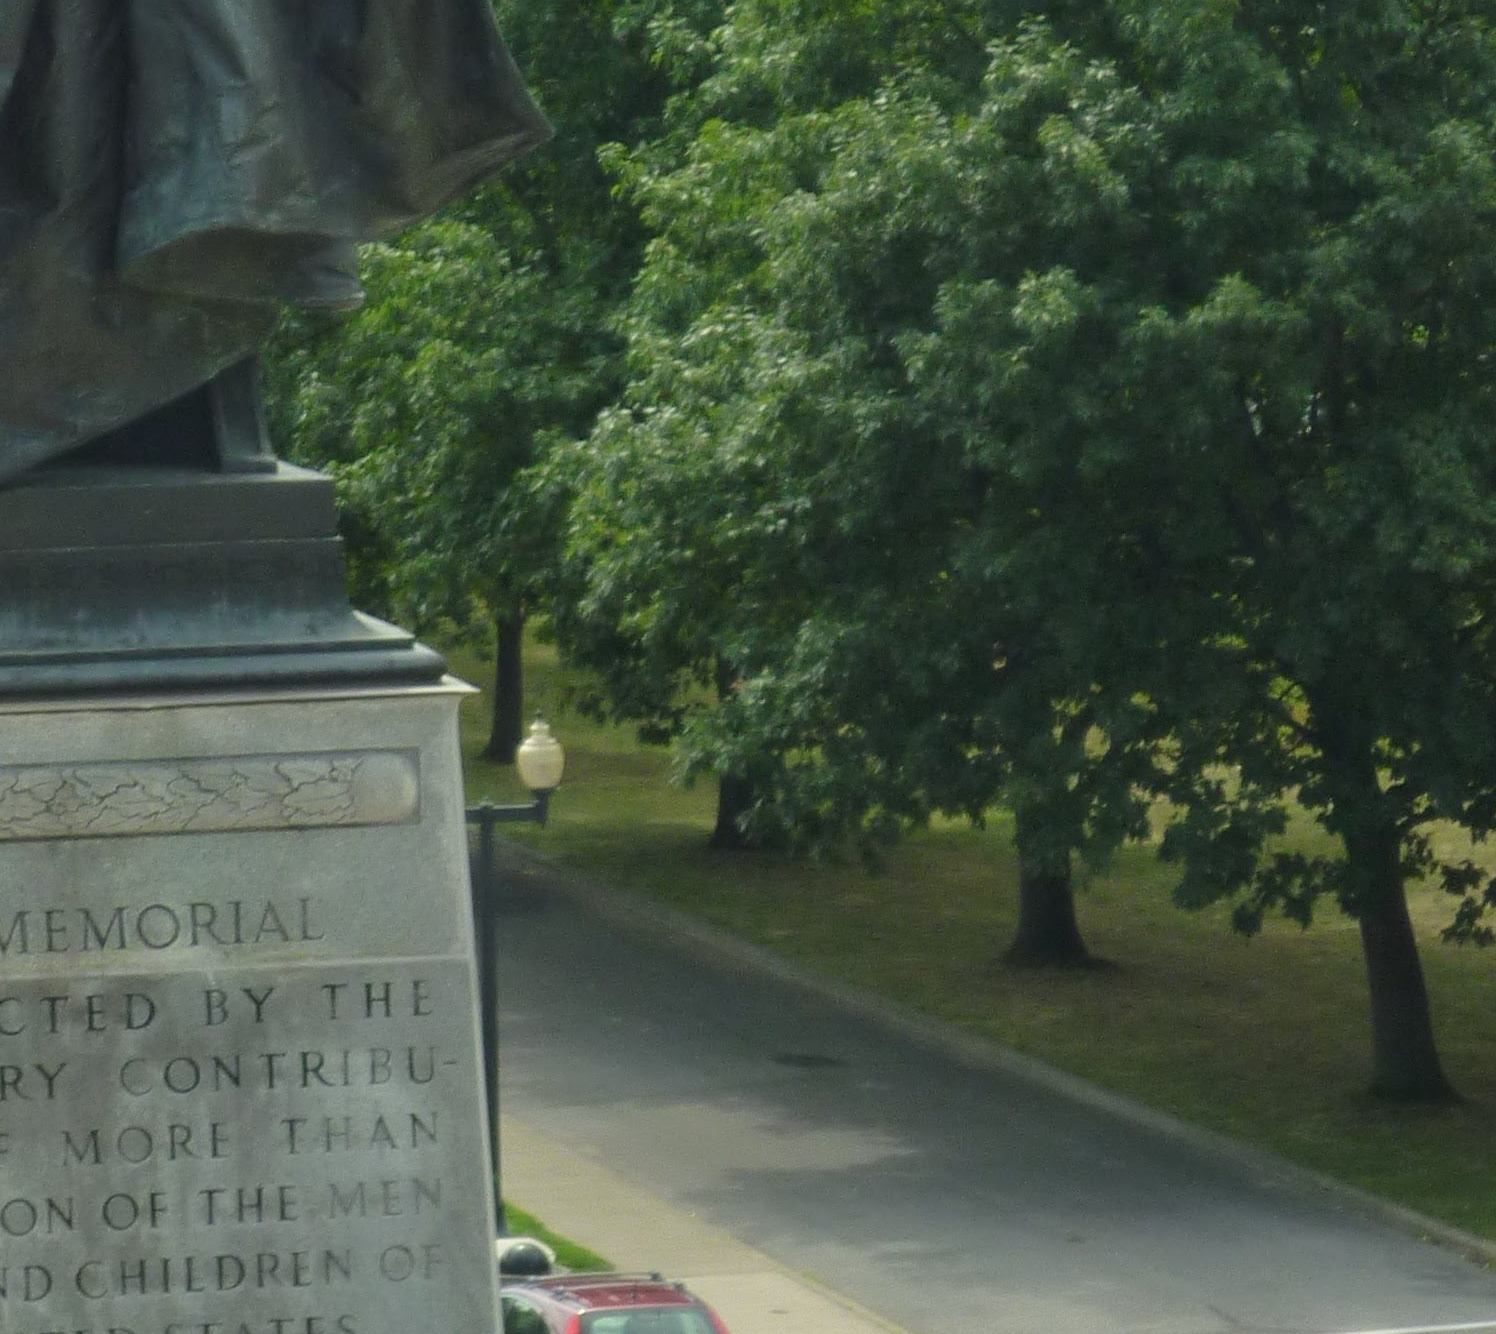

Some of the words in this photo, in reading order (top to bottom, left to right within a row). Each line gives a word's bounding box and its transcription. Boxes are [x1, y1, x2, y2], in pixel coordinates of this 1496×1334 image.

[205, 986, 274, 1026] BY
[321, 979, 432, 1019] THE
[119, 1046, 457, 1096] CONTRIBU-
[61, 1121, 231, 1166] MORE
[280, 1111, 439, 1155] THAN
[102, 1192, 168, 1231] OF
[200, 1183, 299, 1226] THE
[329, 1177, 442, 1219] MEN
[75, 1249, 353, 1299] CHILDREN
[379, 1243, 442, 1282] OF
